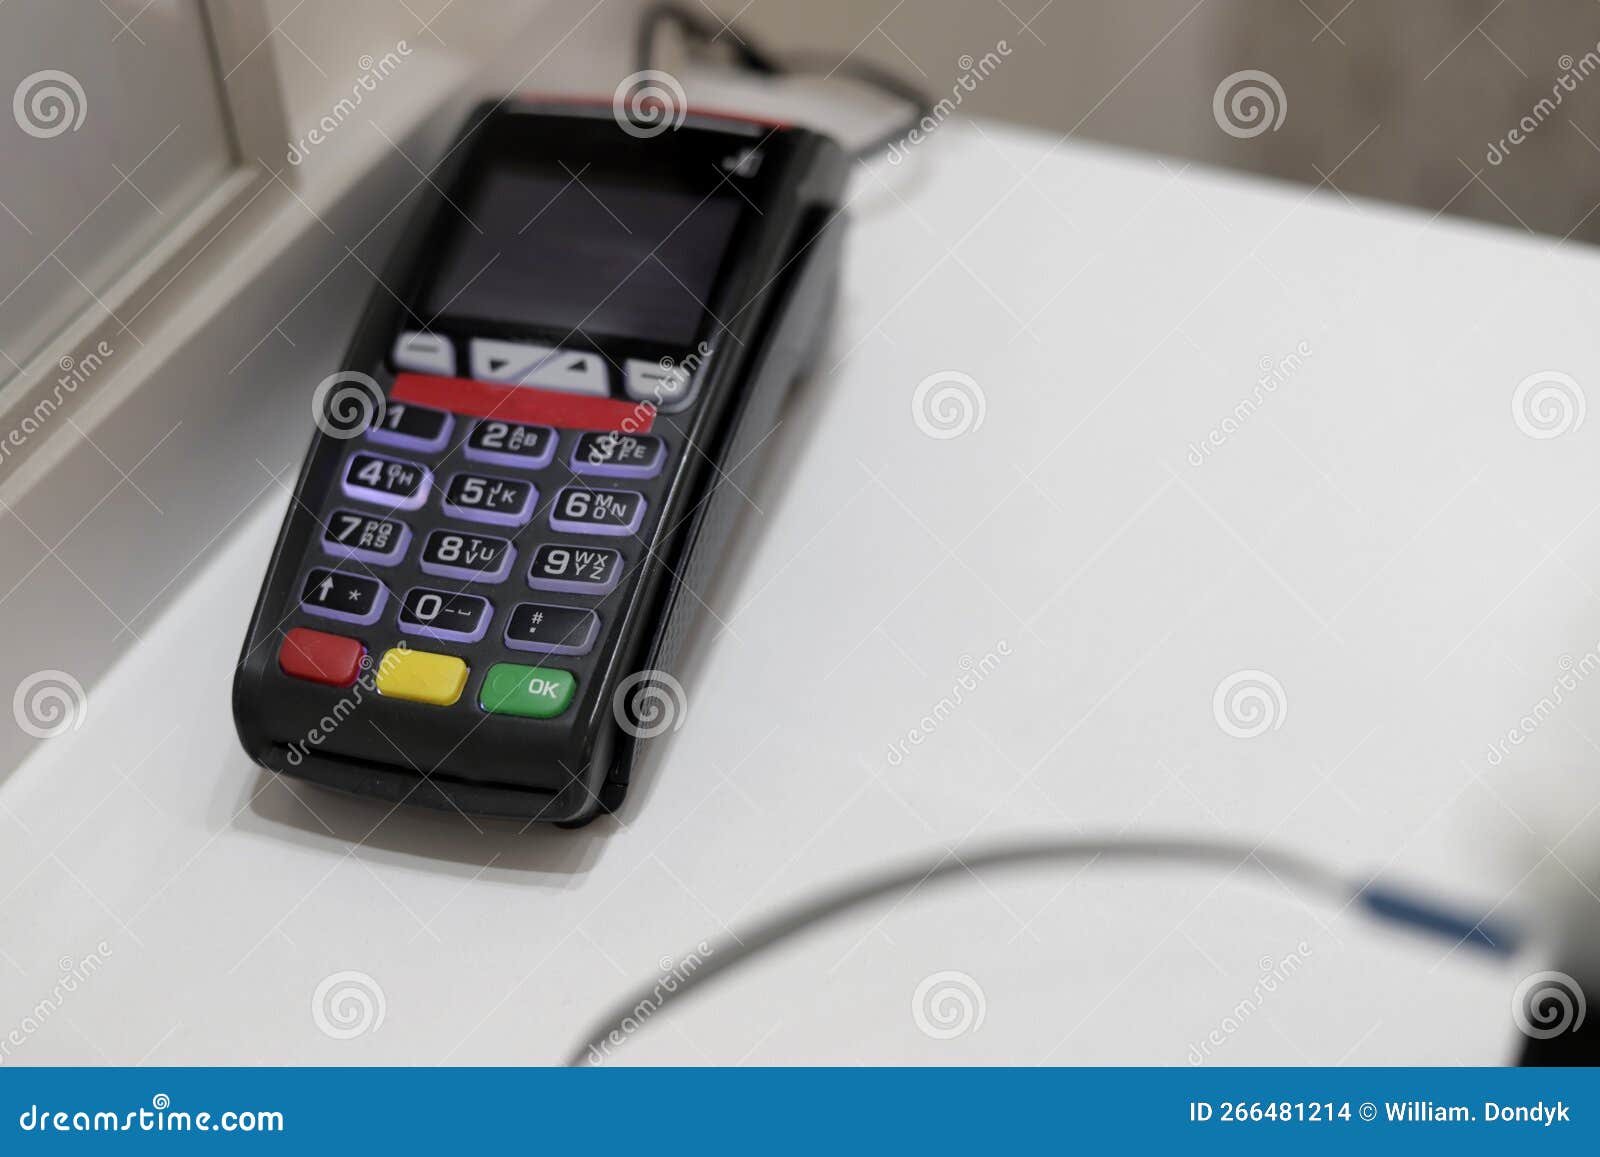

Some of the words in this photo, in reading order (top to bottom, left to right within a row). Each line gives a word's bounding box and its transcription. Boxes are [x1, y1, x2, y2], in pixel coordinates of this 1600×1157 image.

[388, 405, 406, 429] 1
[481, 423, 509, 448] 2
[358, 460, 383, 486] 4
[460, 477, 488, 505] 5
[565, 492, 591, 518] 6
[338, 515, 363, 541] 7
[437, 536, 464, 561] 8
[543, 549, 570, 575] 9
[415, 594, 443, 620] 0
[528, 678, 560, 699] OK
